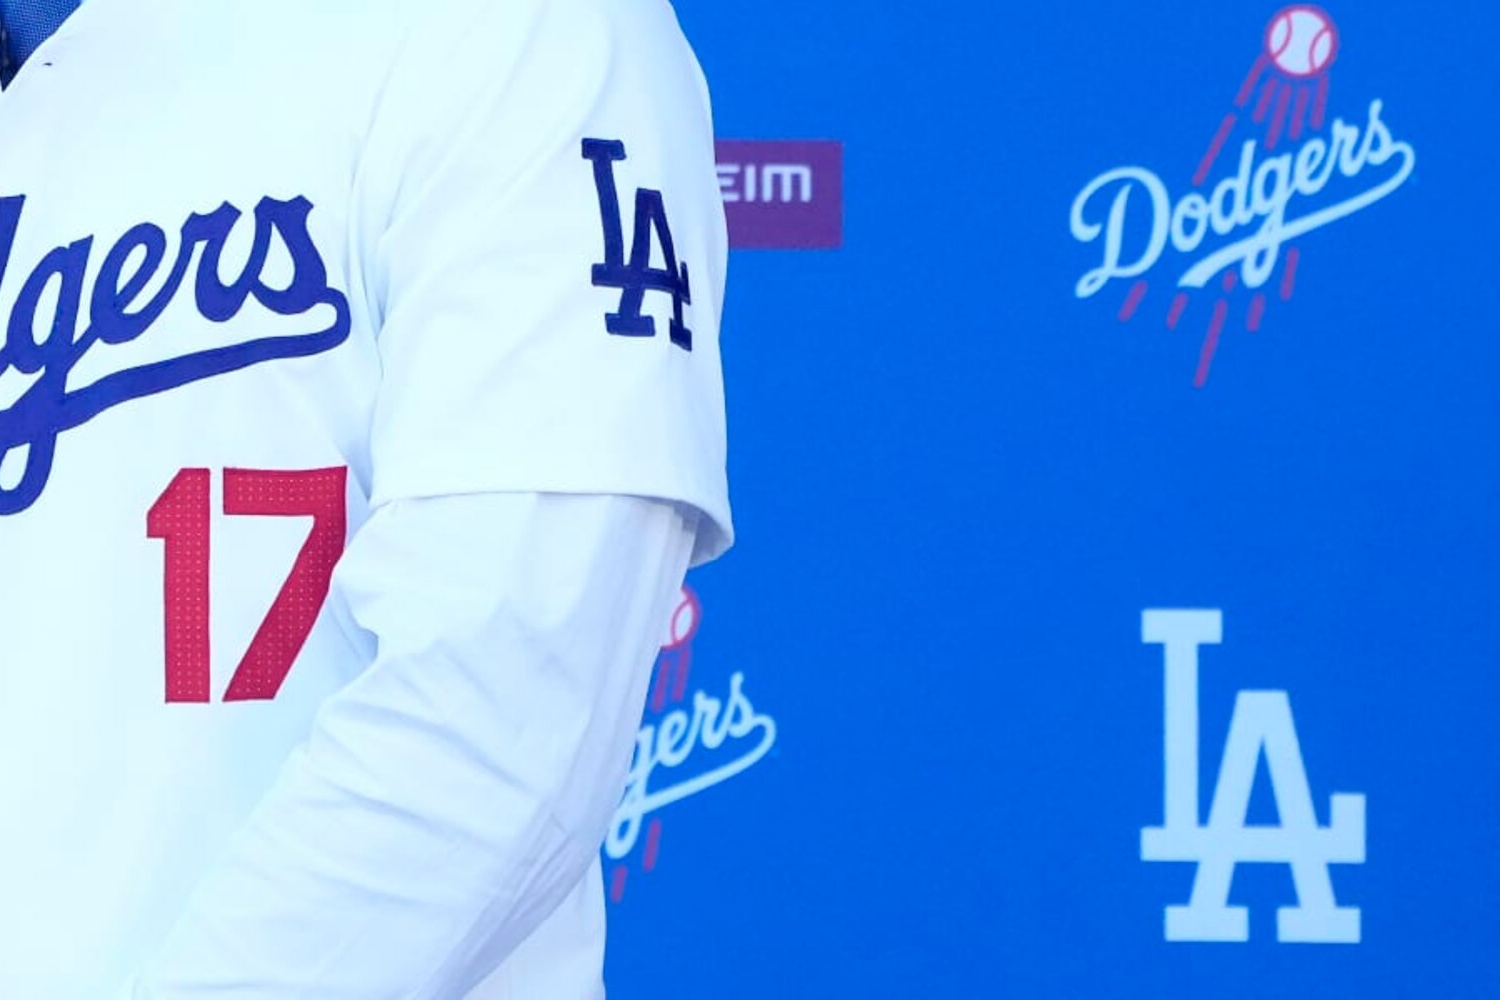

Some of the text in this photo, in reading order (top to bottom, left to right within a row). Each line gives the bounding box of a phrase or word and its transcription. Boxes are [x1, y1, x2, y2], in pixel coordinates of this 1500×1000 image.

[581, 137, 692, 352] LA
[1070, 99, 1415, 298] Dodgers
[146, 466, 348, 704] 17
[605, 671, 777, 859] gers
[1140, 608, 1366, 944] LA
